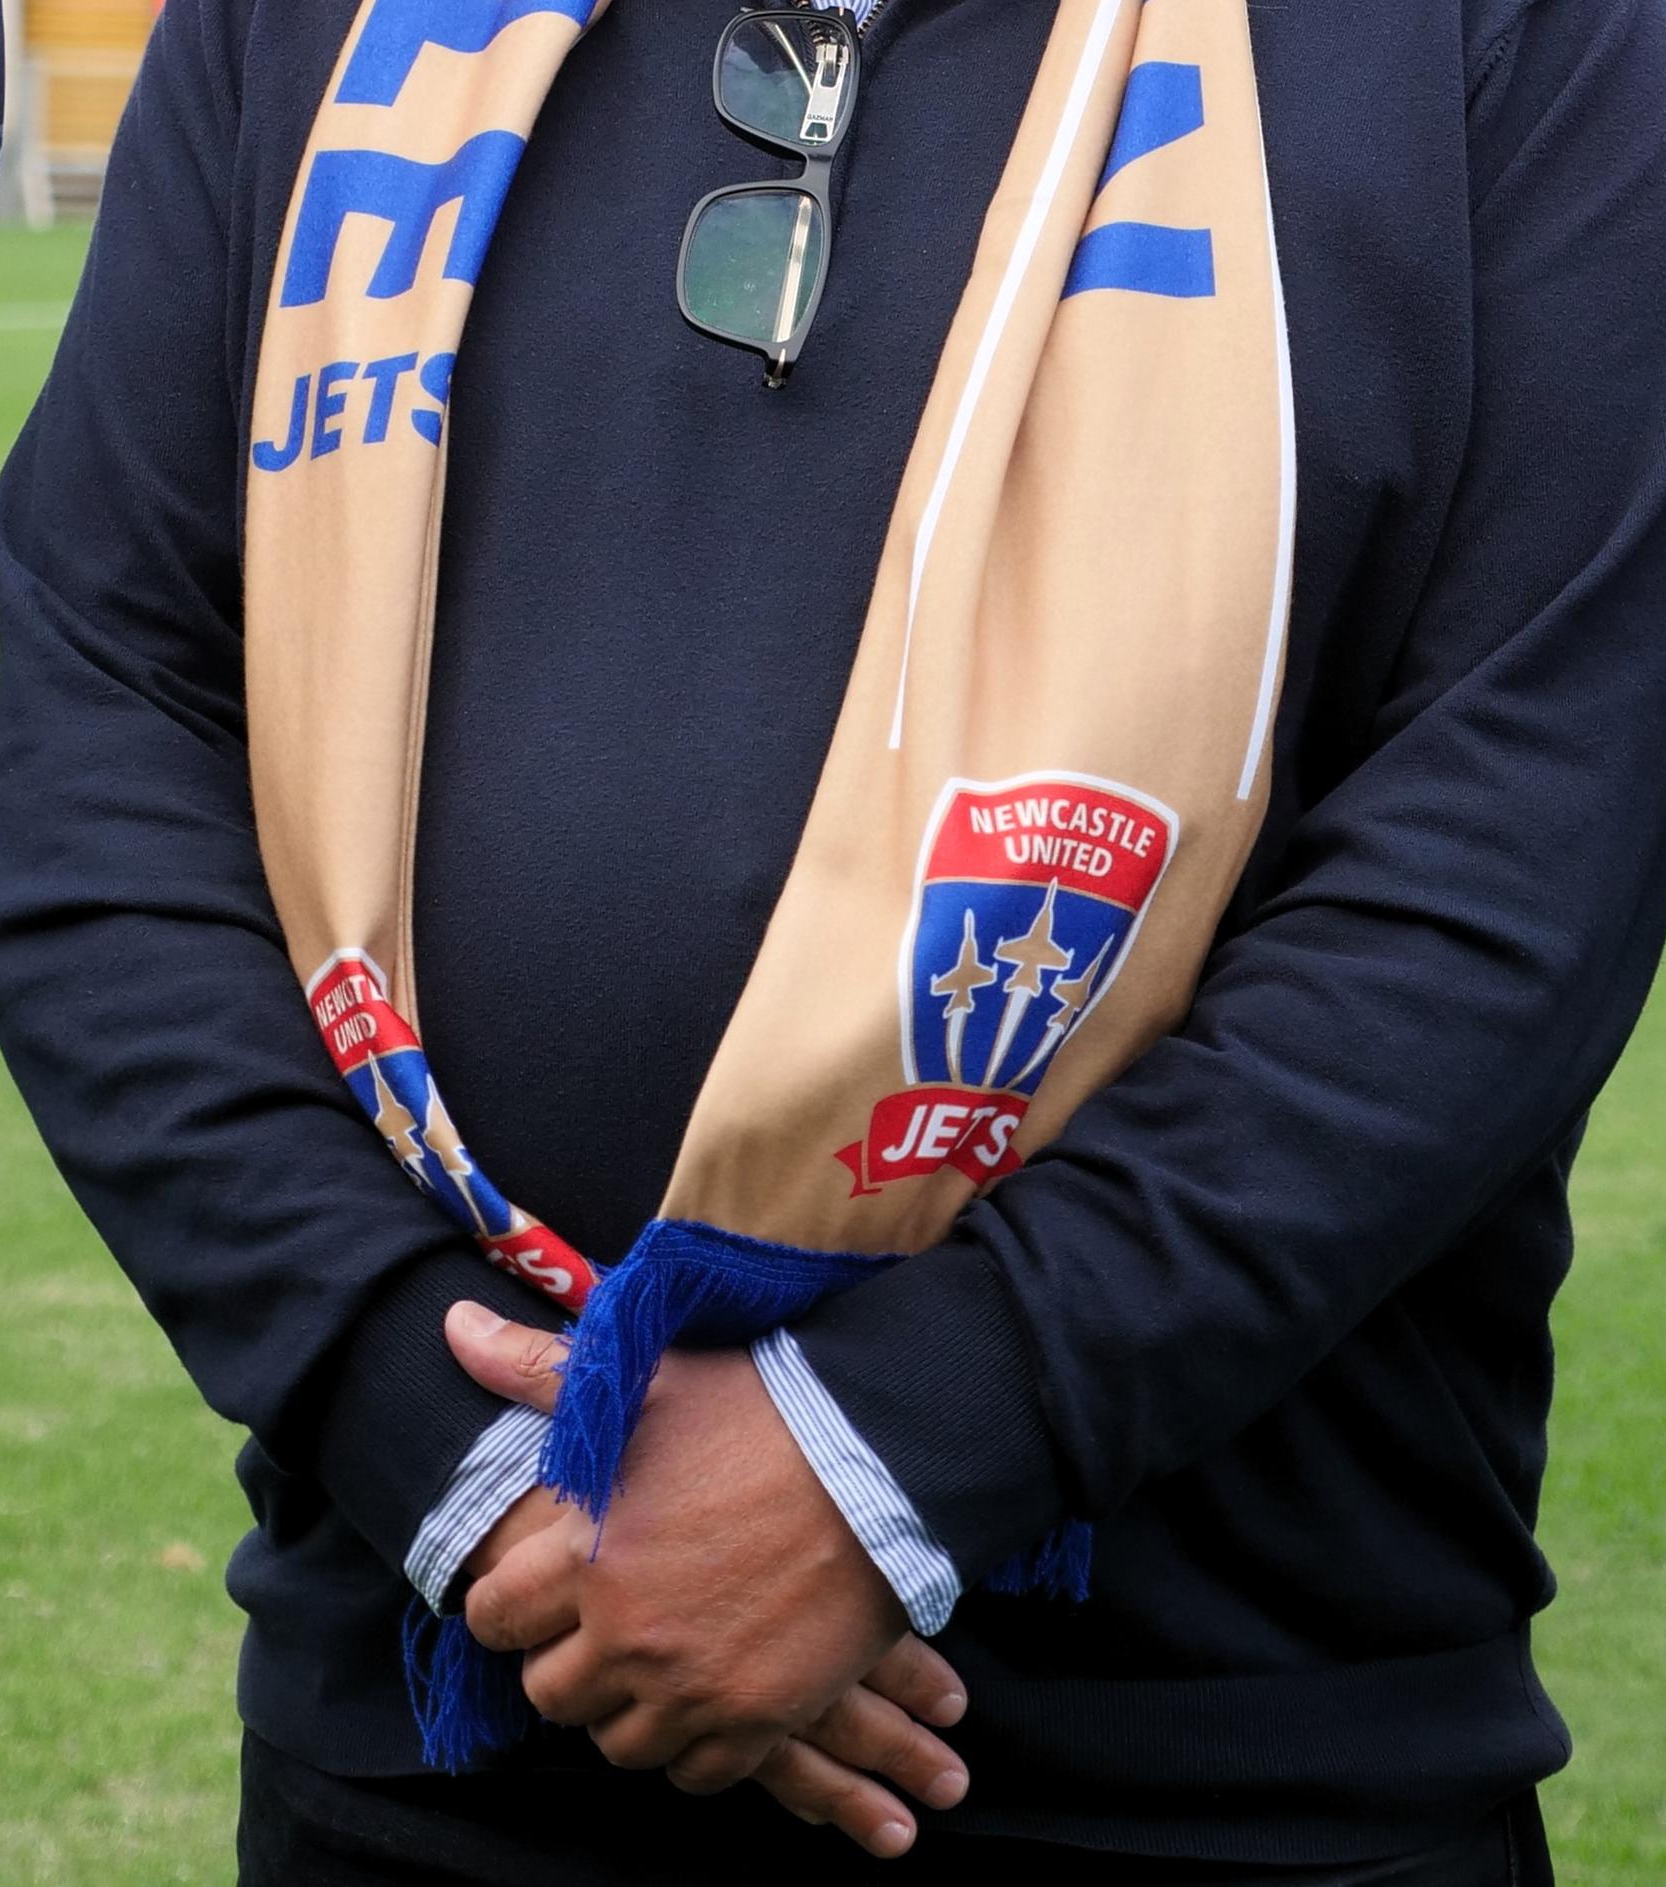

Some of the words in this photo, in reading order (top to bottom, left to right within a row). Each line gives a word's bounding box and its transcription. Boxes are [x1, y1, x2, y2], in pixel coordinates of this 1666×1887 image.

[970, 797, 1156, 858] NEWCASTLE
[1004, 834, 1113, 878] UNITED
[881, 1104, 1020, 1167] JETS
